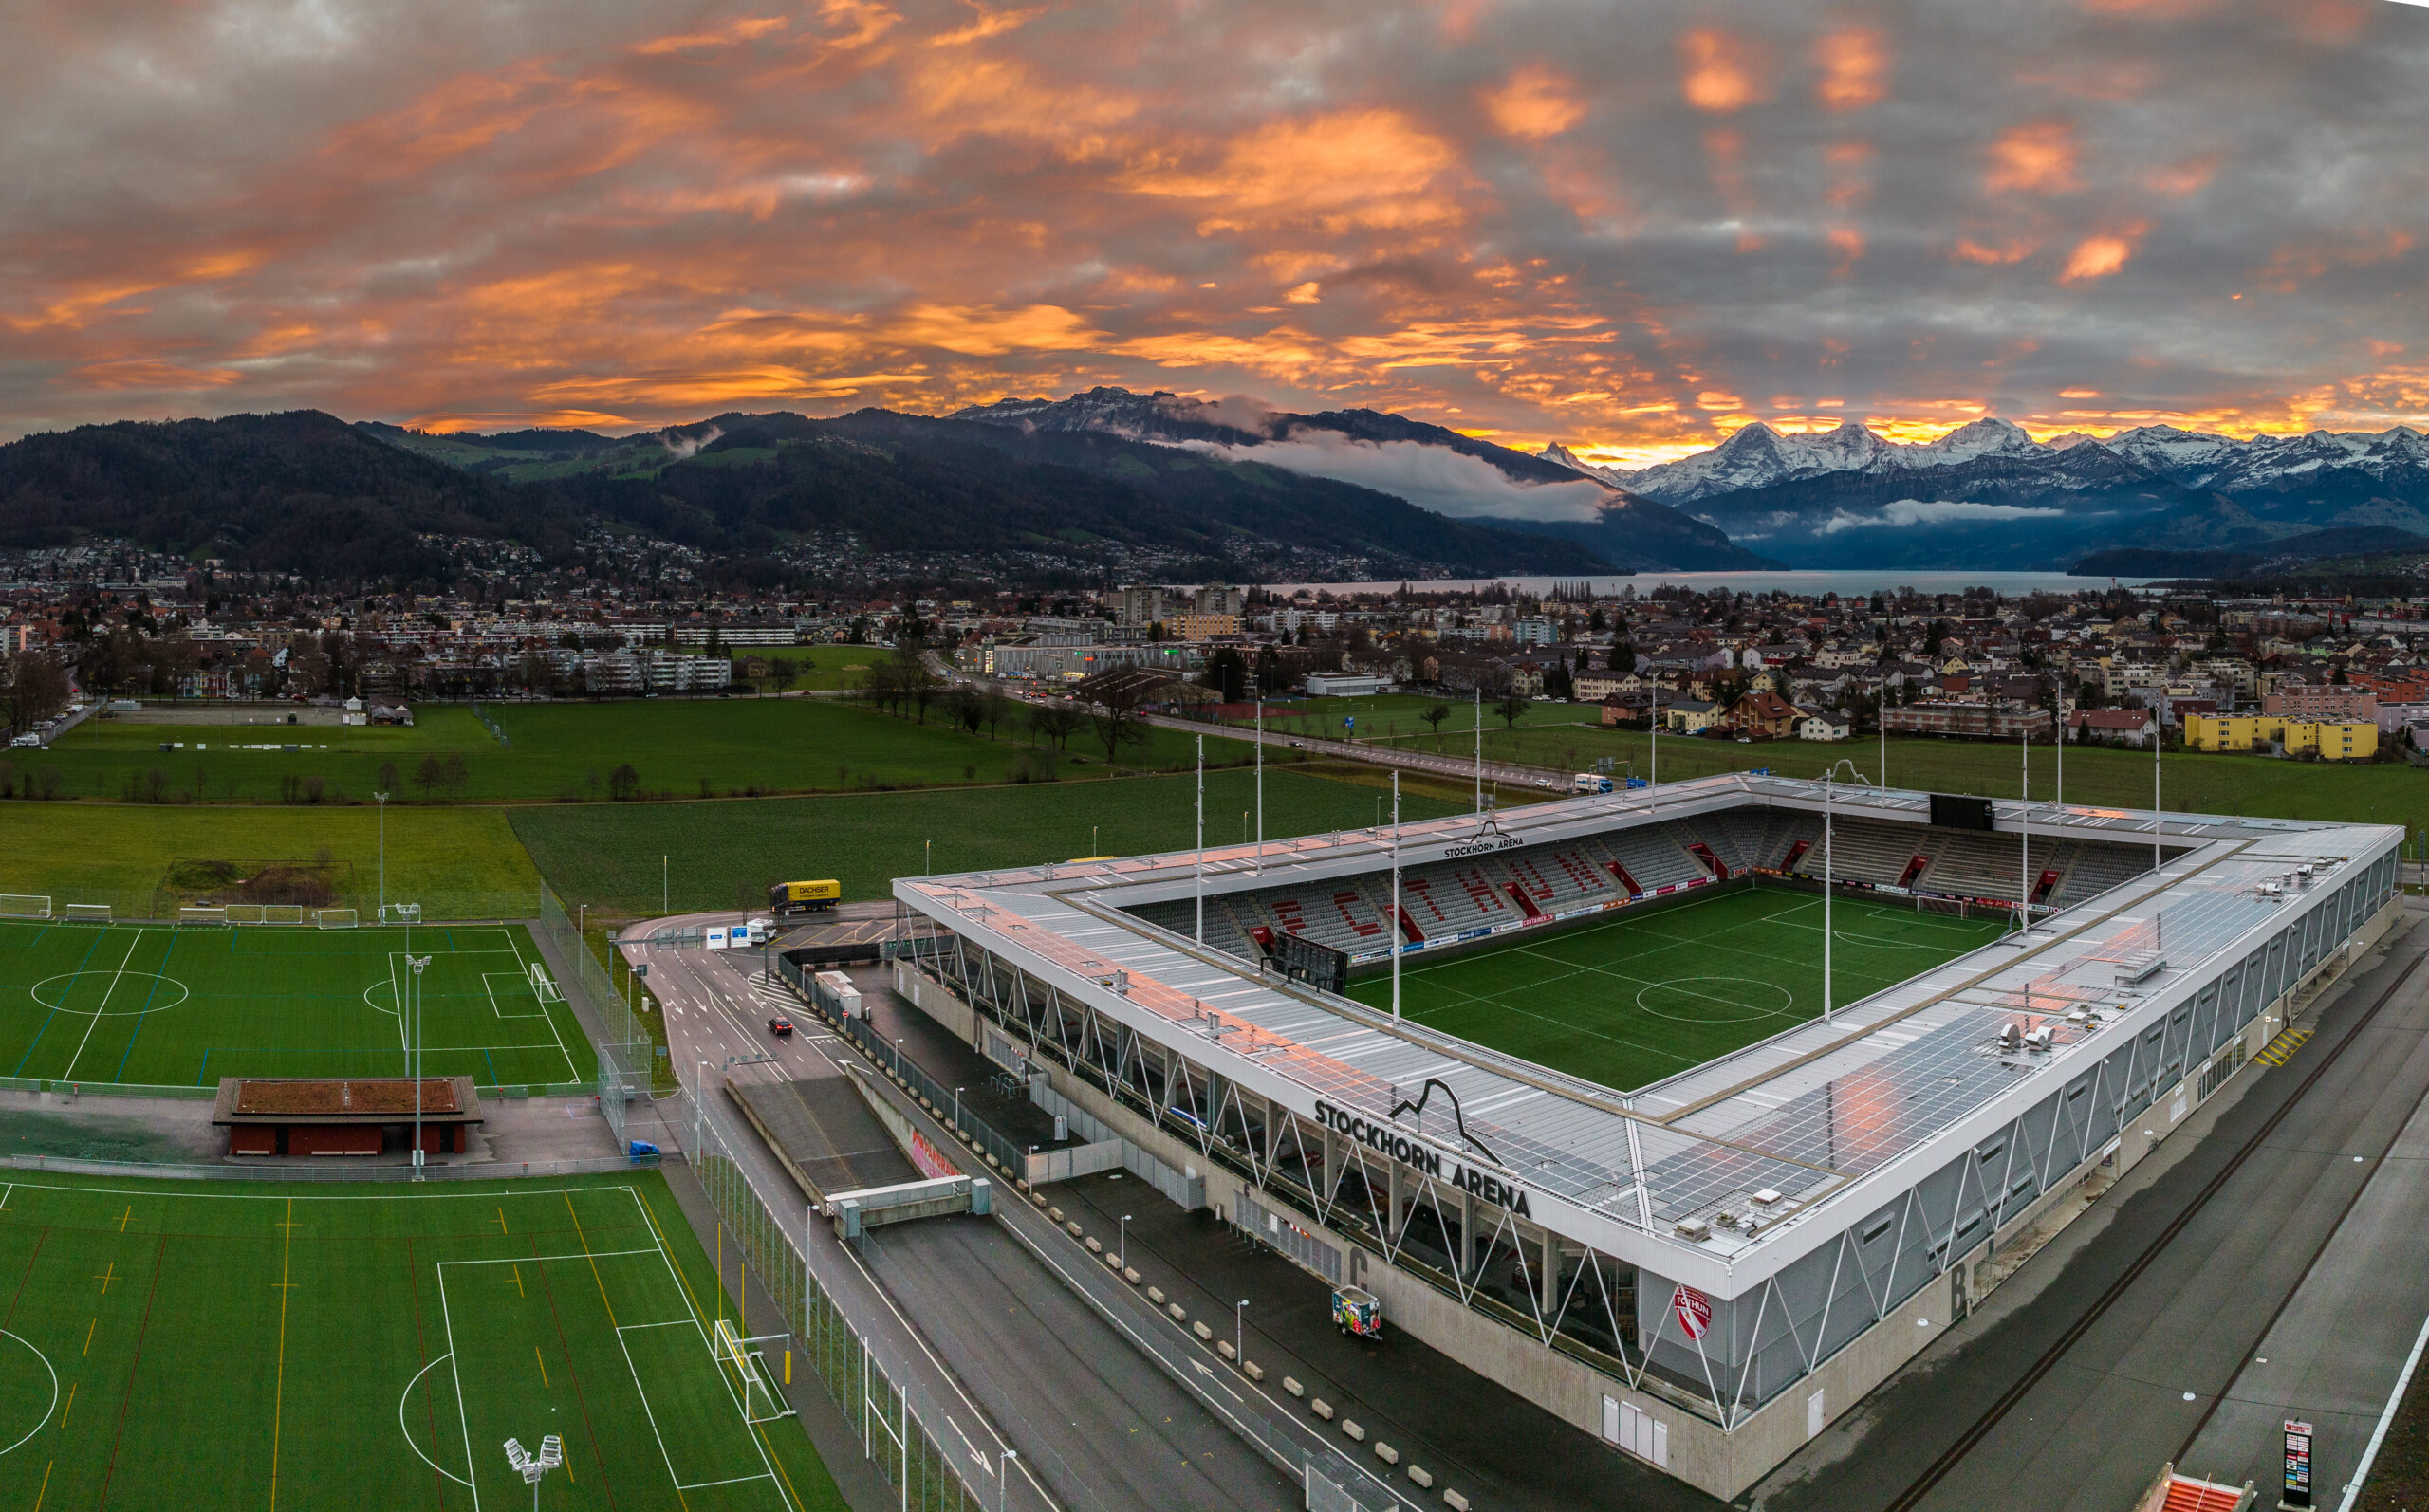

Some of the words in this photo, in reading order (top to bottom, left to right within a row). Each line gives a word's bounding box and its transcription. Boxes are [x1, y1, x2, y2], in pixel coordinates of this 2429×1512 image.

[1444, 842, 1494, 857] STOCKHORN
[1498, 838, 1524, 849] ARENA
[799, 886, 829, 894] DACHSER
[1523, 913, 1554, 927] CONTAINER.CH
[924, 1141, 960, 1176] PANORAM
[1315, 1099, 1440, 1180] STOCKHORN
[1452, 1163, 1532, 1220] ARENA
[1951, 1262, 1968, 1322] B
[1677, 1295, 1687, 1306] FC
[1687, 1299, 1709, 1317] THUN
